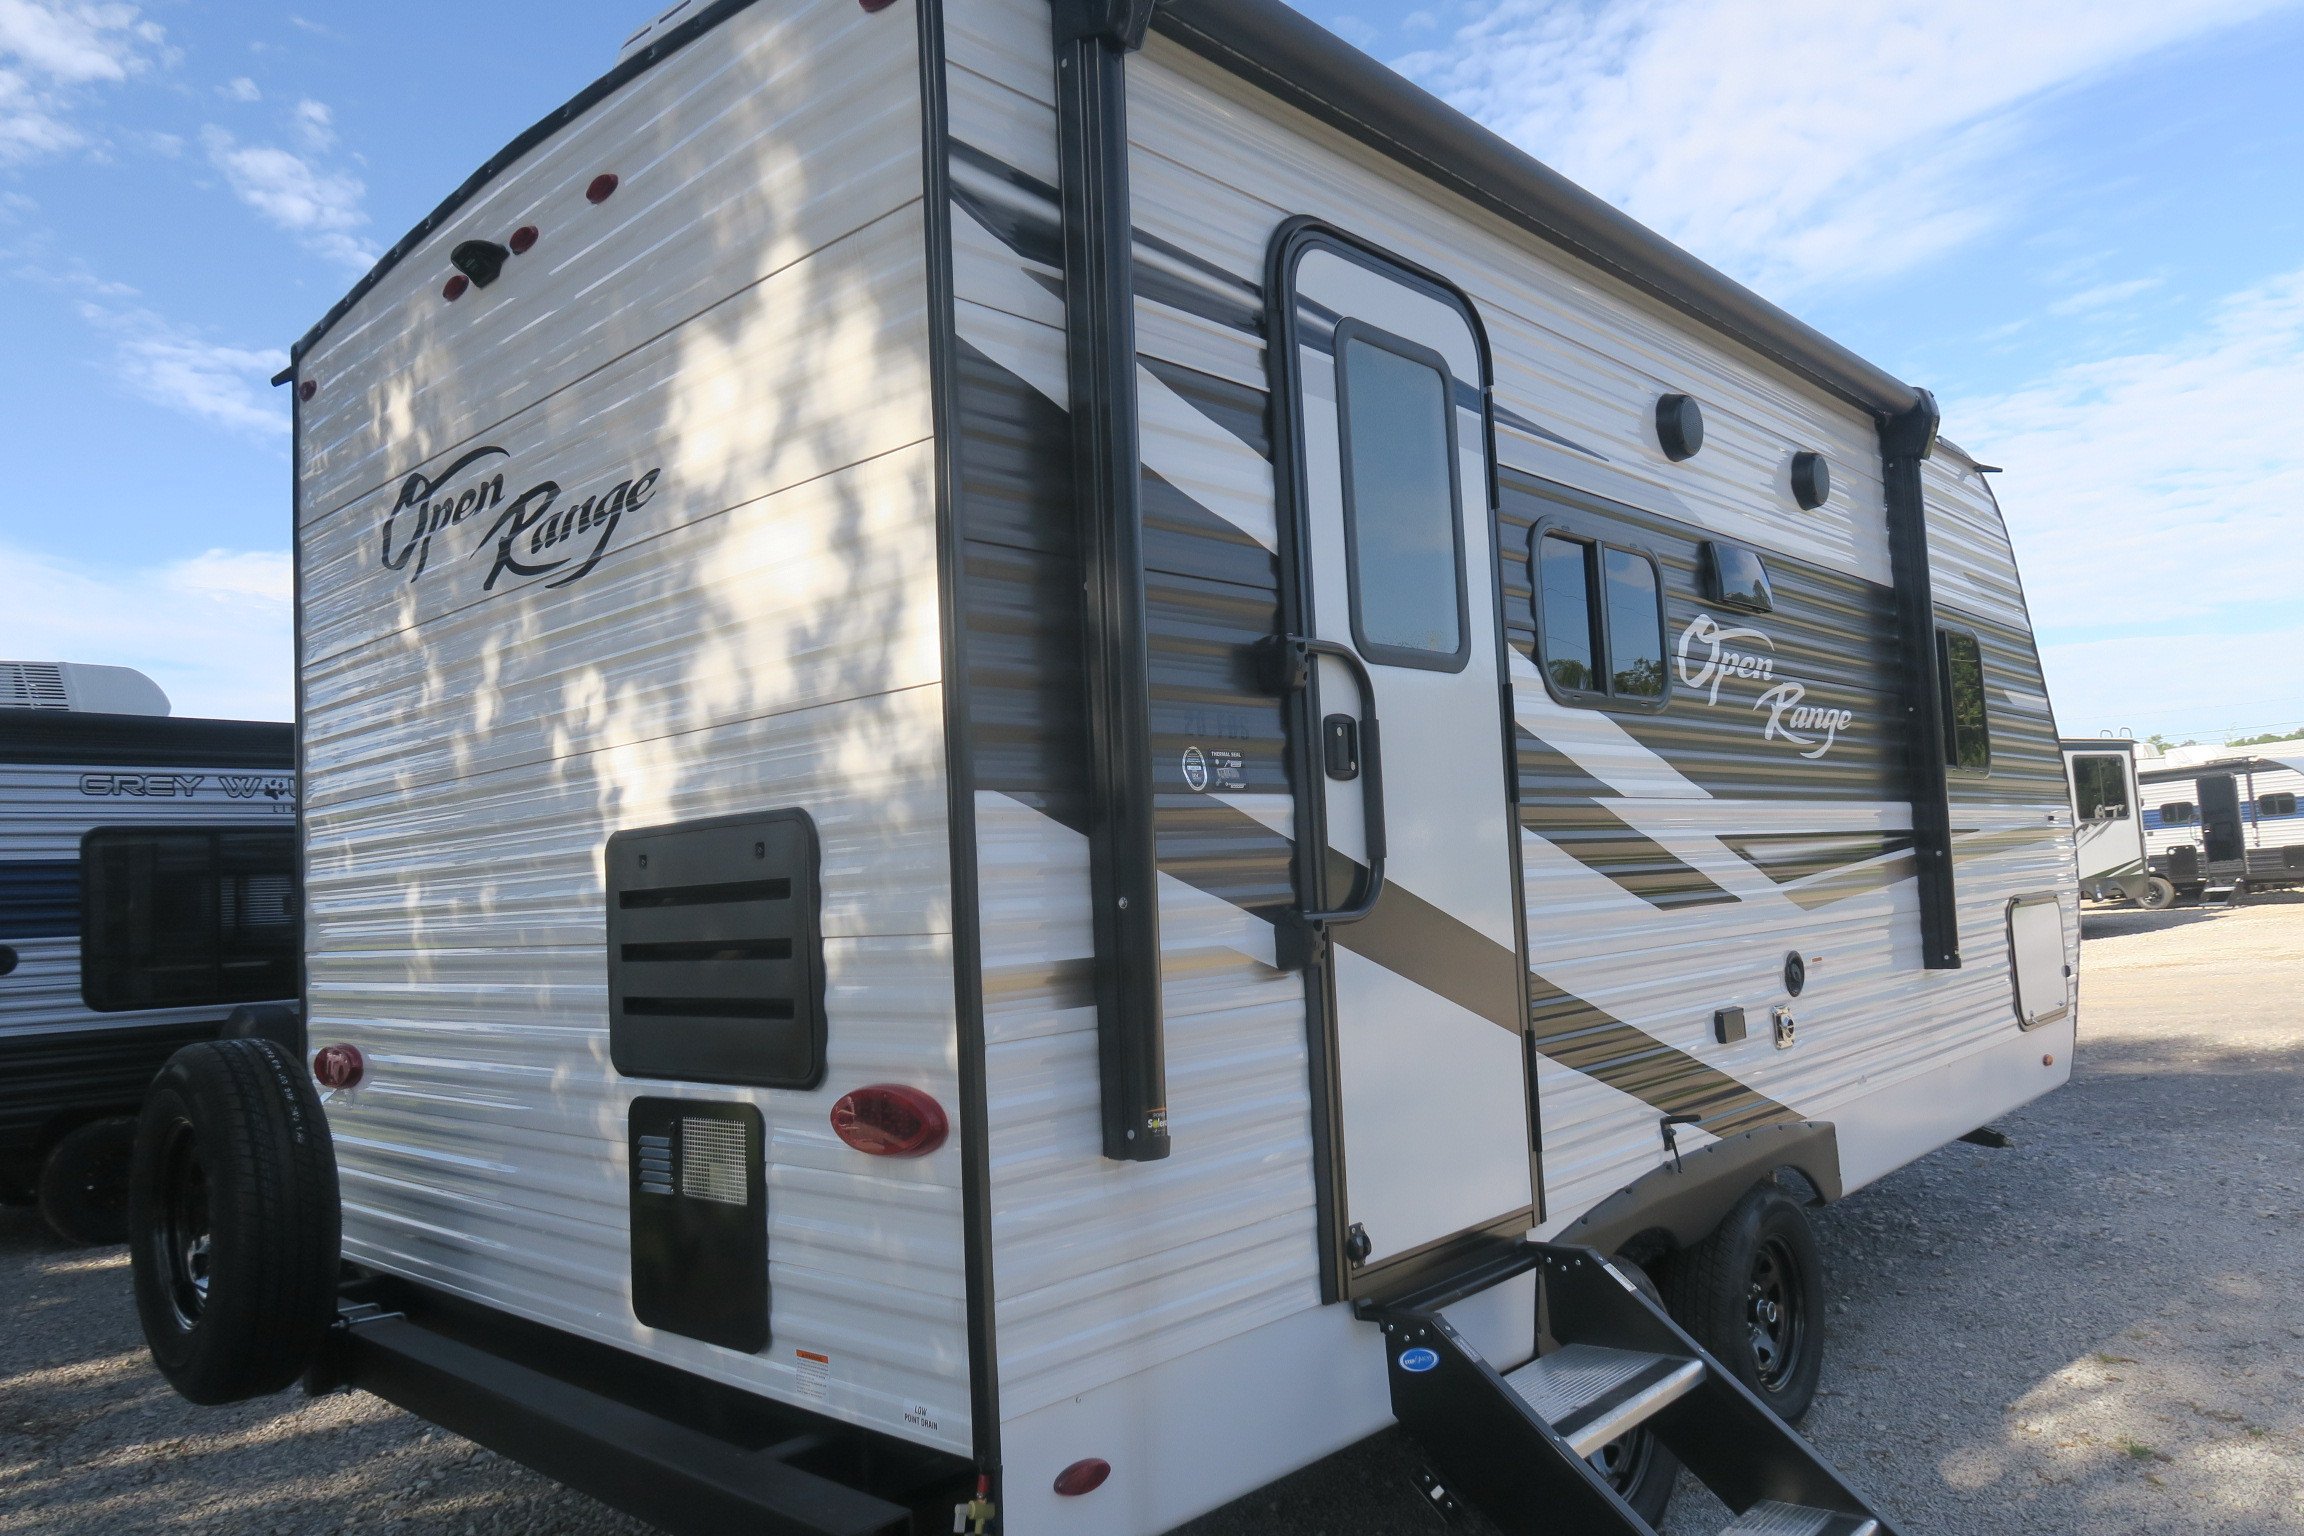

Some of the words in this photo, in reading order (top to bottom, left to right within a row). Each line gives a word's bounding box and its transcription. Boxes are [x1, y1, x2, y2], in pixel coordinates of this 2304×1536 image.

[381, 445, 511, 584] Open
[468, 467, 662, 591] Range
[1676, 613, 1776, 707] Open
[1752, 681, 1853, 760] Range
[1211, 750, 1231, 758] THERMAL
[80, 773, 205, 797] GREY
[904, 1412, 920, 1426] POINT
[920, 1416, 938, 1431] DRAIN
[914, 1404, 928, 1417] LOW
